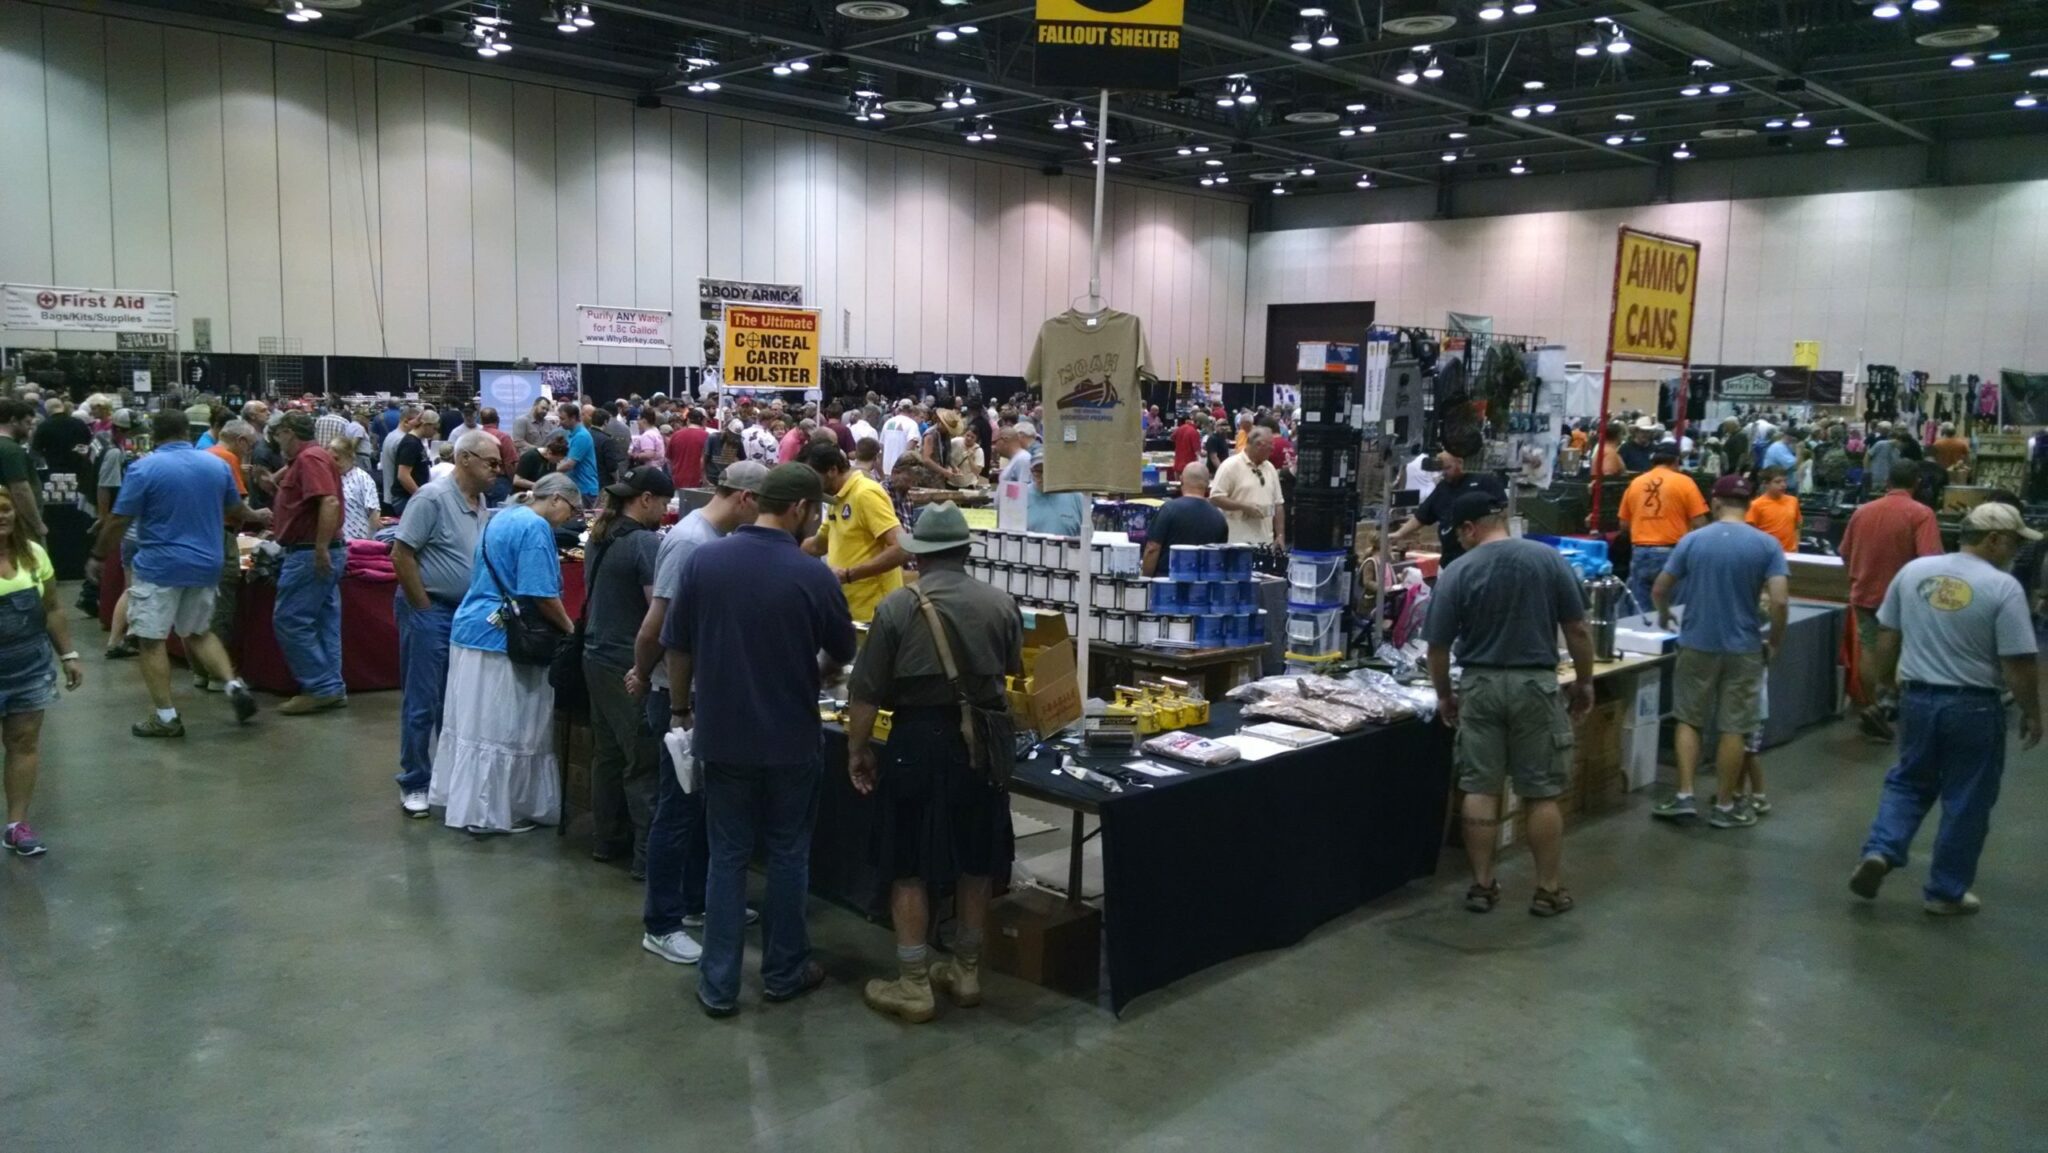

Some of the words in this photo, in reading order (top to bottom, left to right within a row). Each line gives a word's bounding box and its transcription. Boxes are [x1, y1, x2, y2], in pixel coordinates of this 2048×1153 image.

[1038, 25, 1107, 45] FALLOUT
[1110, 27, 1180, 49] SHELTER
[1626, 244, 1689, 295] AMMO
[60, 294, 107, 308] First
[113, 295, 145, 310] Aid
[712, 286, 748, 300] BODY
[752, 288, 799, 303] ARMOR
[40, 311, 143, 324] Bags/Kits/Supplies
[587, 310, 614, 322] Purify
[616, 312, 636, 321] ANY
[638, 313, 664, 324] Water
[733, 313, 758, 326] The
[761, 314, 814, 330] Ultimate
[593, 323, 606, 332] for
[629, 325, 658, 335] Gallon
[1626, 303, 1677, 351] CANS
[586, 334, 665, 345] www.WhyBerkey.com
[746, 350, 799, 365] CARRY
[733, 366, 811, 383] HOLSTER
[1057, 352, 1119, 386] NOAH
